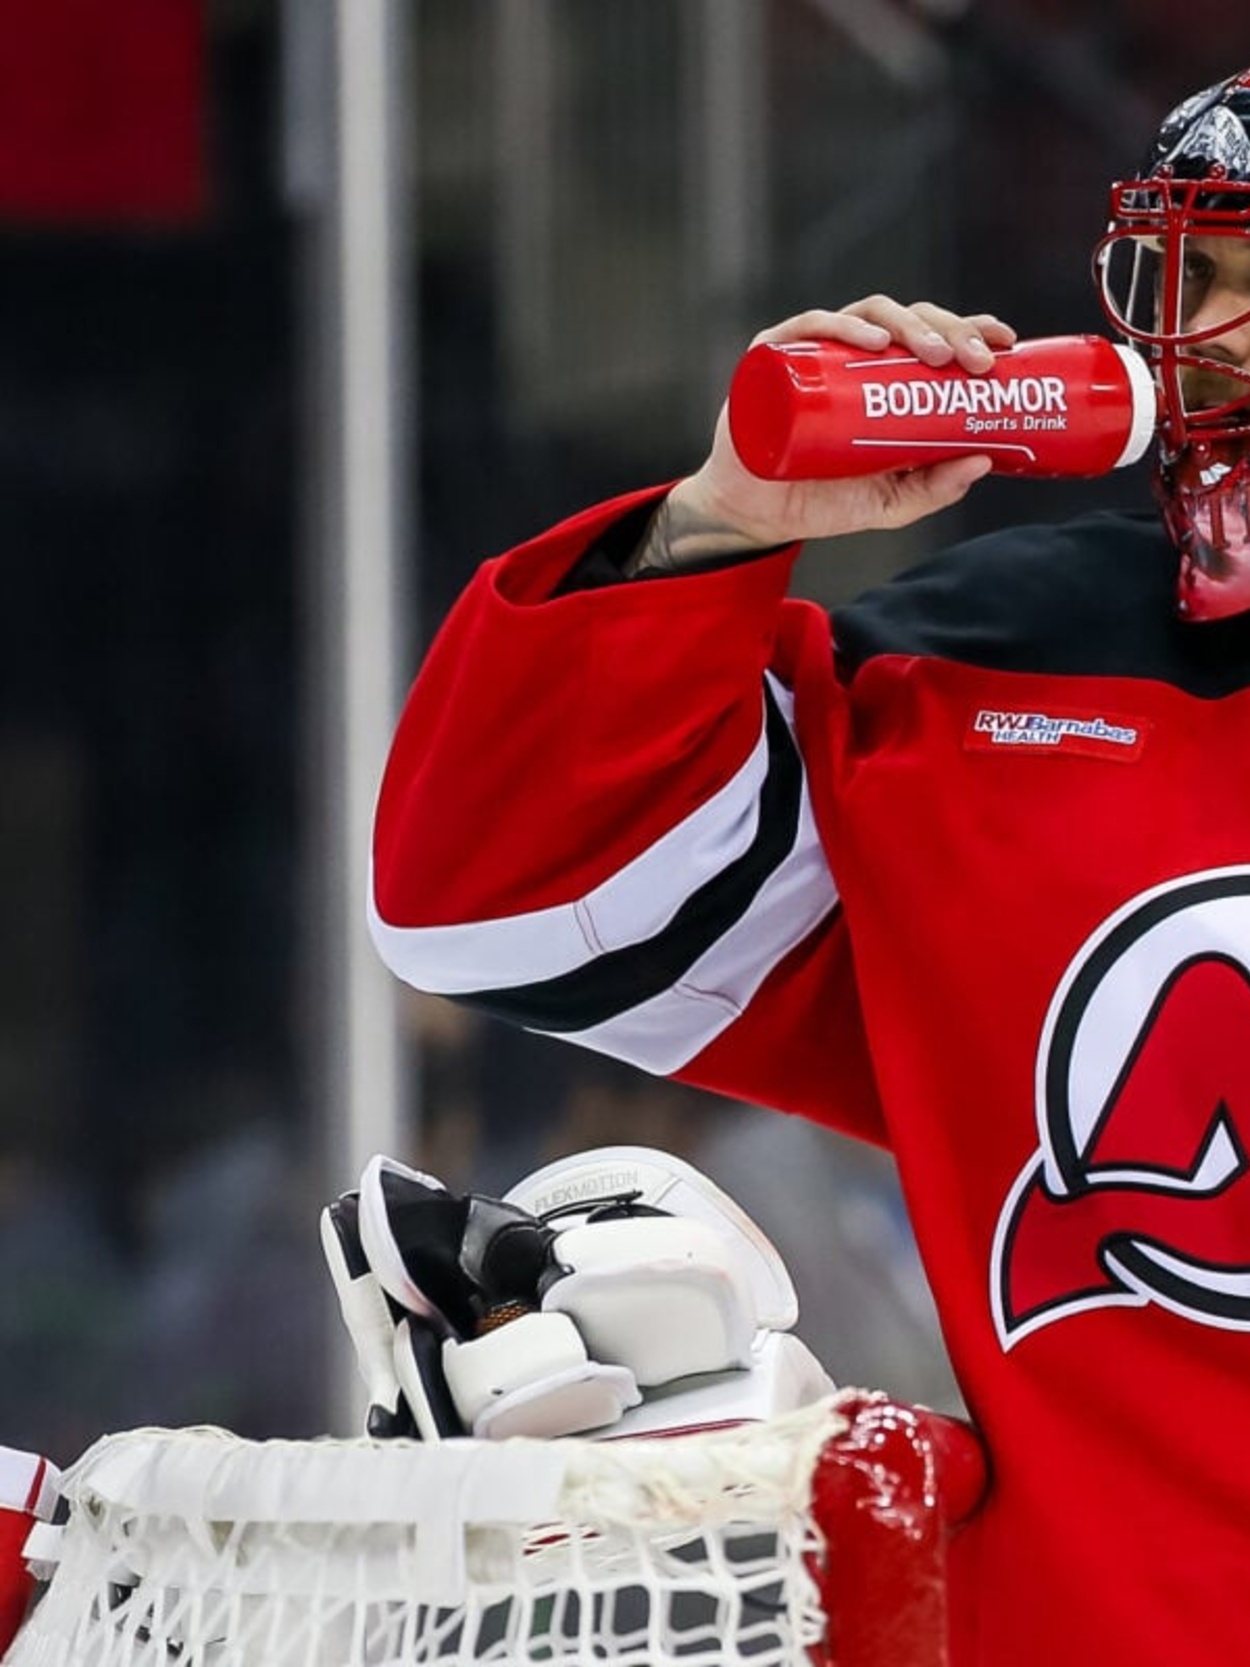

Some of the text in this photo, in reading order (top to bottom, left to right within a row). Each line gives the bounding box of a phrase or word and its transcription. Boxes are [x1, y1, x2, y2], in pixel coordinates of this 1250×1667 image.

[862, 377, 1067, 418] BODYARMOR
[965, 416, 1066, 434] Sports Drink
[994, 731, 1060, 743] HEALTH
